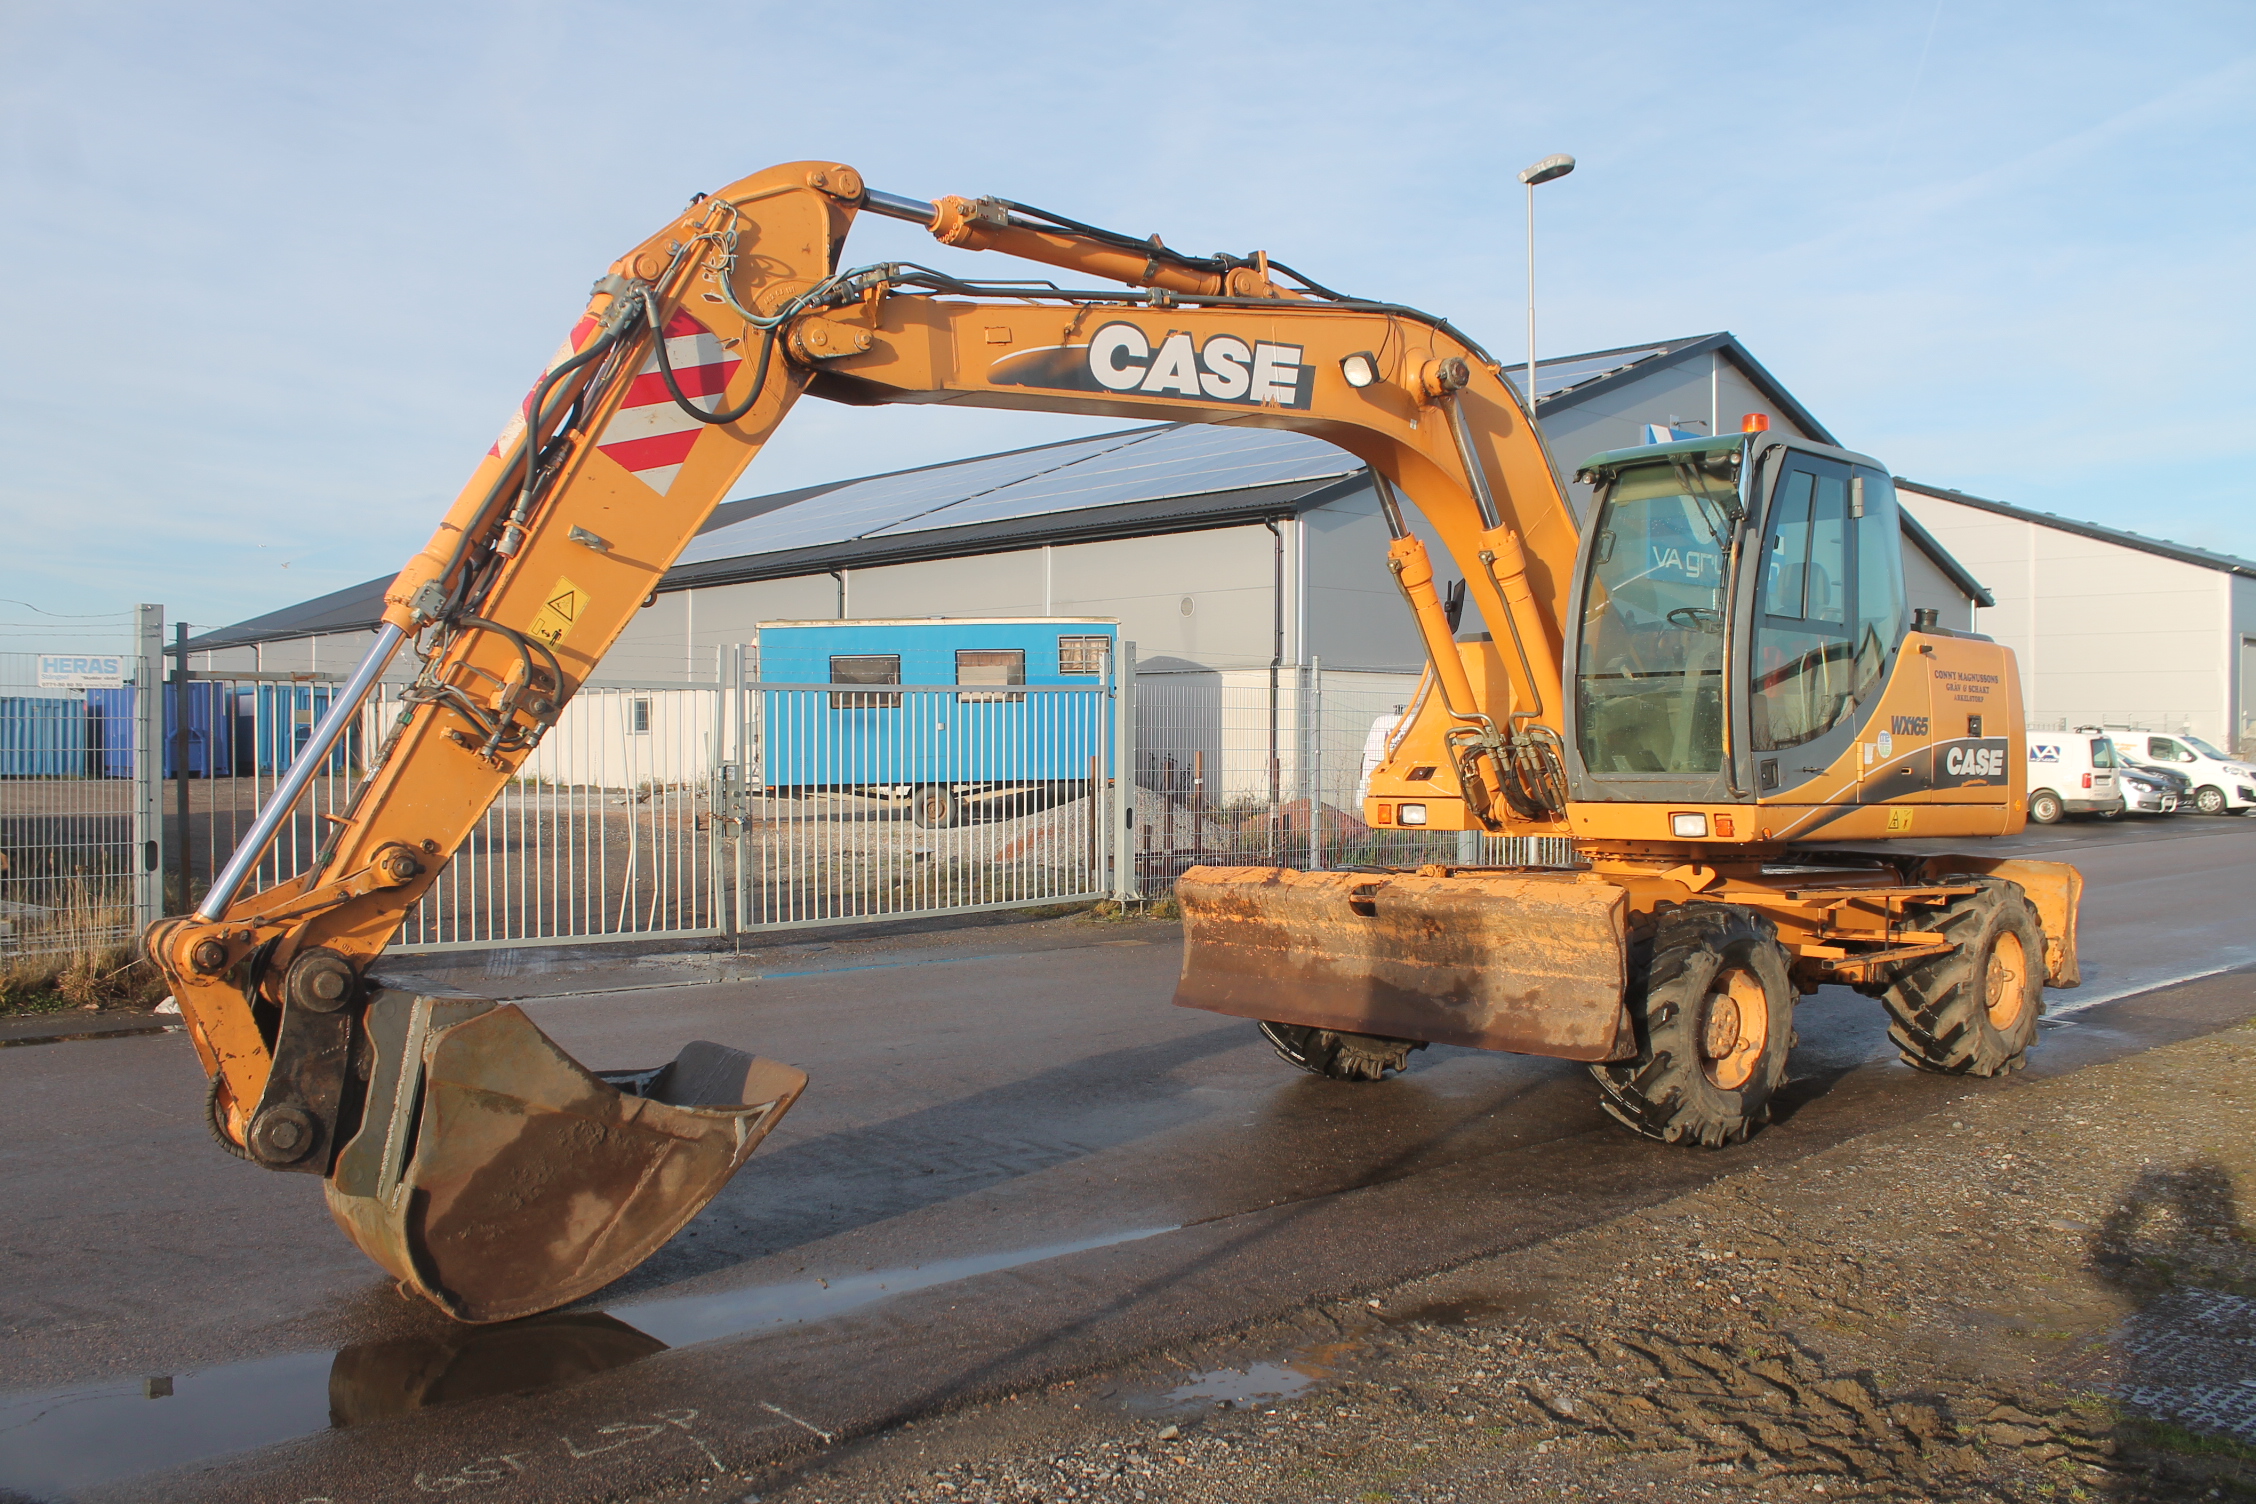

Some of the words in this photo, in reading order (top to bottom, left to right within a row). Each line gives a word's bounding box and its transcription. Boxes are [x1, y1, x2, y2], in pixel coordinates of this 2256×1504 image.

[1089, 323, 1302, 405] CASE
[1652, 545, 1683, 570] VA
[43, 658, 118, 674] HERAS
[1934, 669, 1957, 681] CONNY
[1957, 672, 1999, 683] MAGNUSSONS
[1891, 715, 1929, 736] WX165
[1946, 746, 2004, 776] CASE
